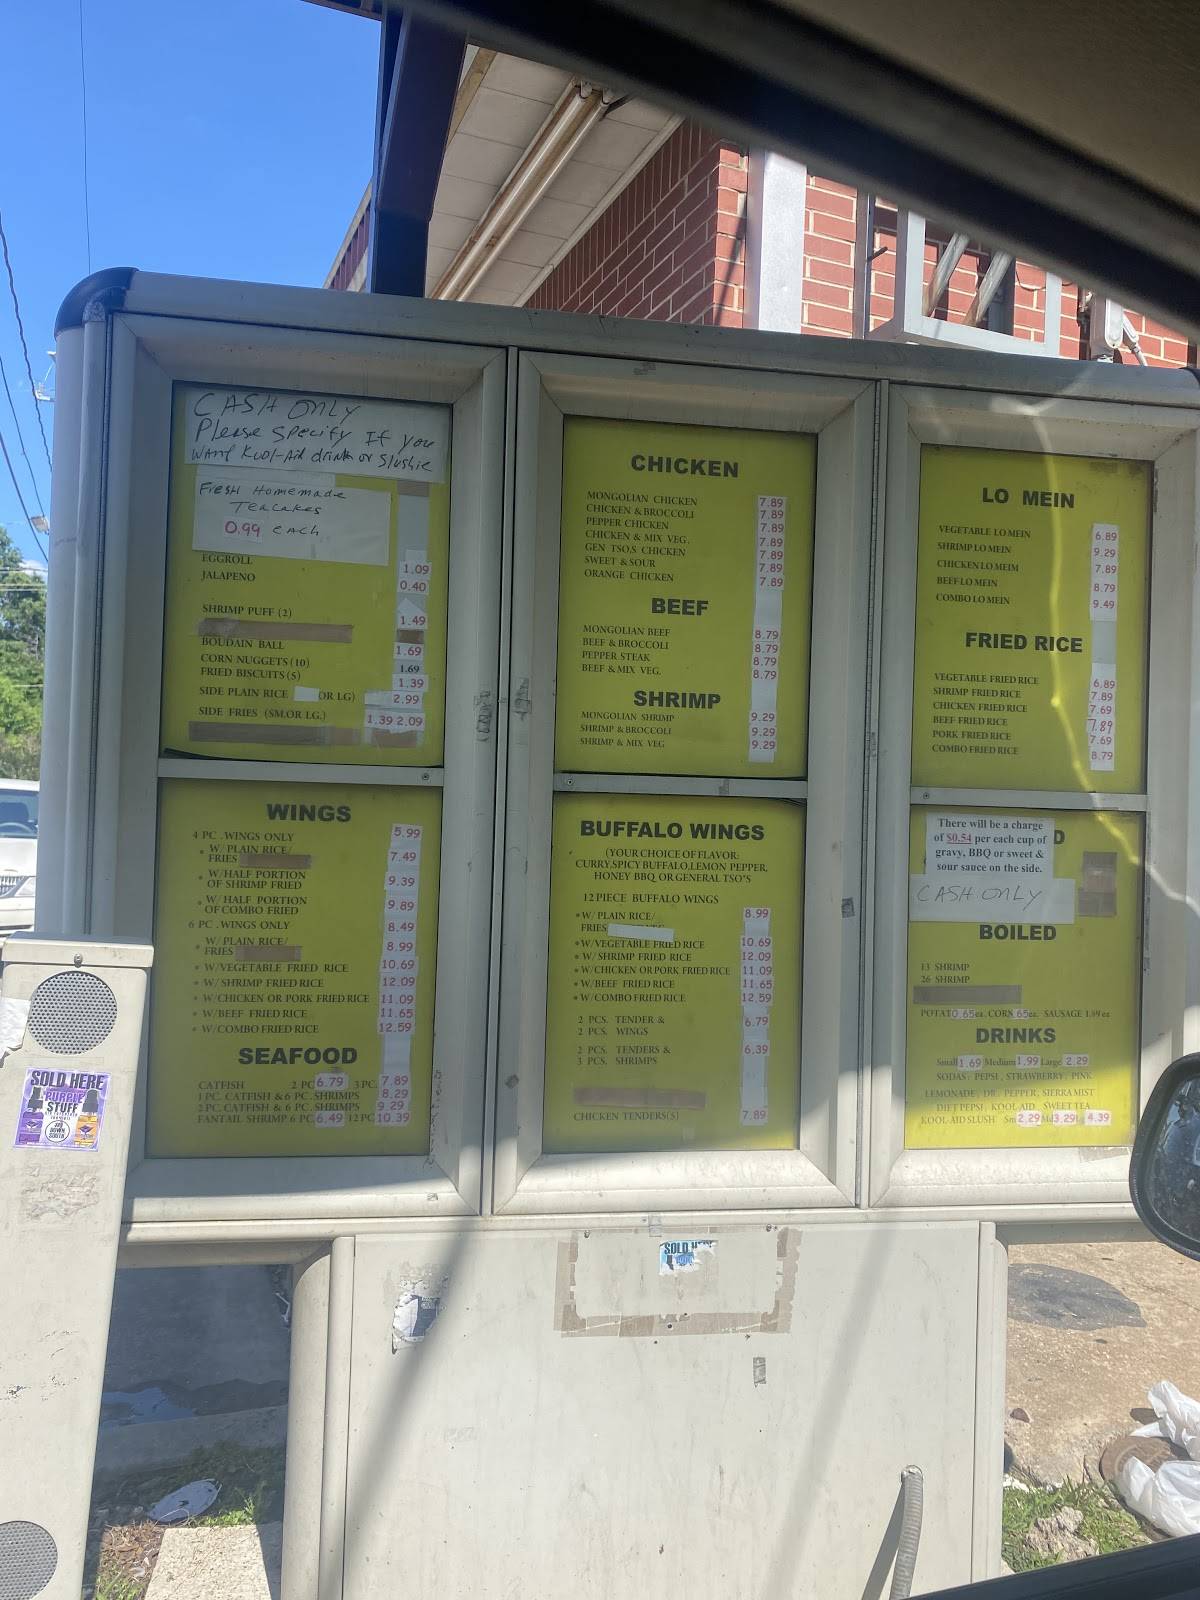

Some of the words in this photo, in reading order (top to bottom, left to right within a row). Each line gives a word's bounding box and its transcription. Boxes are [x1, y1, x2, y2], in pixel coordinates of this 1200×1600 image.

[194, 392, 278, 417] CASH
[196, 418, 264, 441] Please
[359, 454, 372, 462] or
[631, 455, 738, 478] CHICKEN
[588, 491, 648, 503] MONGOLIAN
[654, 495, 698, 506] CHICKEN
[760, 498, 783, 508] 7.89
[983, 488, 1009, 504] LO
[1022, 491, 1074, 508] MEIN
[587, 504, 630, 515] CHICKEN
[644, 508, 694, 519] BROCCOLI
[760, 510, 784, 519] 7.89
[225, 520, 260, 537] 0.99
[586, 518, 621, 527] PEPPER
[624, 519, 669, 530] CHICKEN
[760, 523, 784, 532] 7.89
[939, 525, 990, 536] VEGETABLE
[586, 530, 630, 540] CHICKEN
[633, 533, 640, 542] &
[645, 534, 662, 542] MIX
[1096, 532, 1117, 541] 6.89
[201, 554, 253, 565] EGGROLL
[584, 557, 614, 565] SWEET
[630, 558, 656, 567] SOUR
[404, 564, 429, 574] 1.09
[201, 571, 256, 582] JALAPENO
[584, 570, 624, 580] ORANGE
[400, 581, 426, 592] 0.40
[652, 598, 709, 616] BEEF
[1093, 600, 1114, 609] 9.49
[202, 604, 244, 616] SHRIMP
[248, 606, 274, 617] PUFF
[401, 616, 426, 626] 1.49
[583, 624, 644, 636] MONGOLIAN
[648, 628, 670, 636] BEEF
[755, 630, 778, 640] 8.79
[202, 637, 253, 648] BOUDAIN
[258, 640, 285, 650] BALL
[582, 638, 604, 647] BEEF
[966, 632, 1027, 650] FRIED
[1035, 636, 1082, 652] RICE
[396, 646, 421, 656] 1.69
[754, 644, 778, 653] 8.79
[201, 654, 232, 664] CORN
[582, 651, 617, 660] PEPPER
[620, 652, 650, 661] STEAK
[201, 668, 232, 678] FRIED
[401, 665, 420, 673] 1.69
[618, 666, 635, 674] MIX
[934, 673, 987, 682] VEGETABLE
[400, 679, 424, 688] 1.39
[200, 687, 224, 696] SIDE
[228, 688, 259, 697] PLAIN
[263, 689, 288, 698] RICE
[393, 694, 420, 704] 2.99
[634, 690, 720, 709] SHRIMP
[199, 707, 223, 716] SIDE
[230, 708, 258, 718] FRIES
[1090, 705, 1112, 714] 7.69
[368, 715, 392, 725] 1.39
[397, 716, 422, 726] 2.09
[751, 712, 775, 722] 9.29
[932, 730, 958, 739] PORK
[932, 744, 967, 753] COMBO
[267, 804, 351, 822] WINGS
[939, 819, 967, 828] There
[970, 820, 987, 828] will
[990, 820, 1001, 829] be
[1012, 820, 1043, 831] charge
[394, 828, 420, 838] 5.99
[580, 821, 682, 838] BUFFALO
[690, 823, 764, 840] WINGS
[264, 832, 294, 842] ONLY
[934, 834, 944, 842] of
[947, 834, 972, 844] $0.54
[975, 836, 990, 844] per
[993, 835, 1011, 843] each
[1014, 837, 1033, 845] cup
[1037, 836, 1047, 844] of
[390, 852, 416, 861] 7.49
[936, 849, 965, 859] gravy,
[969, 849, 990, 859] BBQ
[1007, 850, 1033, 858] sweet
[1036, 850, 1044, 858] &
[1004, 864, 1018, 872] the
[1022, 864, 1042, 873] side.
[256, 870, 306, 880] PORTION
[594, 872, 630, 881] HONEY
[634, 872, 655, 882] BBQ
[208, 880, 223, 888] OF
[226, 880, 266, 889] SHRIMP
[270, 880, 302, 890] FRIED
[388, 877, 415, 887] 9.39
[917, 885, 974, 902] CASH
[632, 894, 680, 903] BUFFALO
[684, 894, 718, 904] WINGS
[388, 900, 414, 911] 9.89
[745, 909, 769, 918] 8.99
[388, 922, 414, 932] 8.49
[980, 924, 1057, 940] BOILED
[387, 942, 412, 951] 8.99
[324, 964, 349, 972] RICE
[382, 960, 414, 970] 10.69
[221, 979, 262, 988] SHRIMP
[383, 978, 415, 987] 12.09
[381, 995, 414, 1004] 11.09
[380, 1009, 413, 1018] 11.65
[616, 1016, 655, 1024] TENDER
[379, 1022, 412, 1032] 12.59
[976, 1028, 1056, 1044] DRINKS
[744, 1045, 768, 1054] 6.39
[238, 1048, 358, 1065] SEAFOOD
[959, 1059, 981, 1068] 1.69
[985, 1058, 1016, 1066] Medium
[1017, 1056, 1039, 1065] 1.99
[1041, 1059, 1061, 1067] Large
[1066, 1057, 1088, 1065] 2.29
[31, 1071, 66, 1087] SOLD
[70, 1073, 104, 1090] HERE
[382, 1076, 408, 1086] 7.89
[1072, 1072, 1092, 1080] PINK
[199, 1081, 244, 1090] CATFISH
[316, 1077, 343, 1088] 6.79
[45, 1091, 85, 1103] PURPLE
[314, 1092, 360, 1100] SHRIMPS
[382, 1089, 408, 1099] 8.29
[47, 1102, 78, 1113] STUFF
[378, 1101, 404, 1111] 9.29
[247, 1114, 287, 1123] SHRIMP
[316, 1113, 343, 1124] 6.49
[377, 1113, 409, 1123] 10.39
[1018, 1113, 1040, 1122] 2.29
[1054, 1113, 1075, 1122] 3.29
[1088, 1113, 1109, 1122] 4.39
[664, 1242, 689, 1254] SOLD
